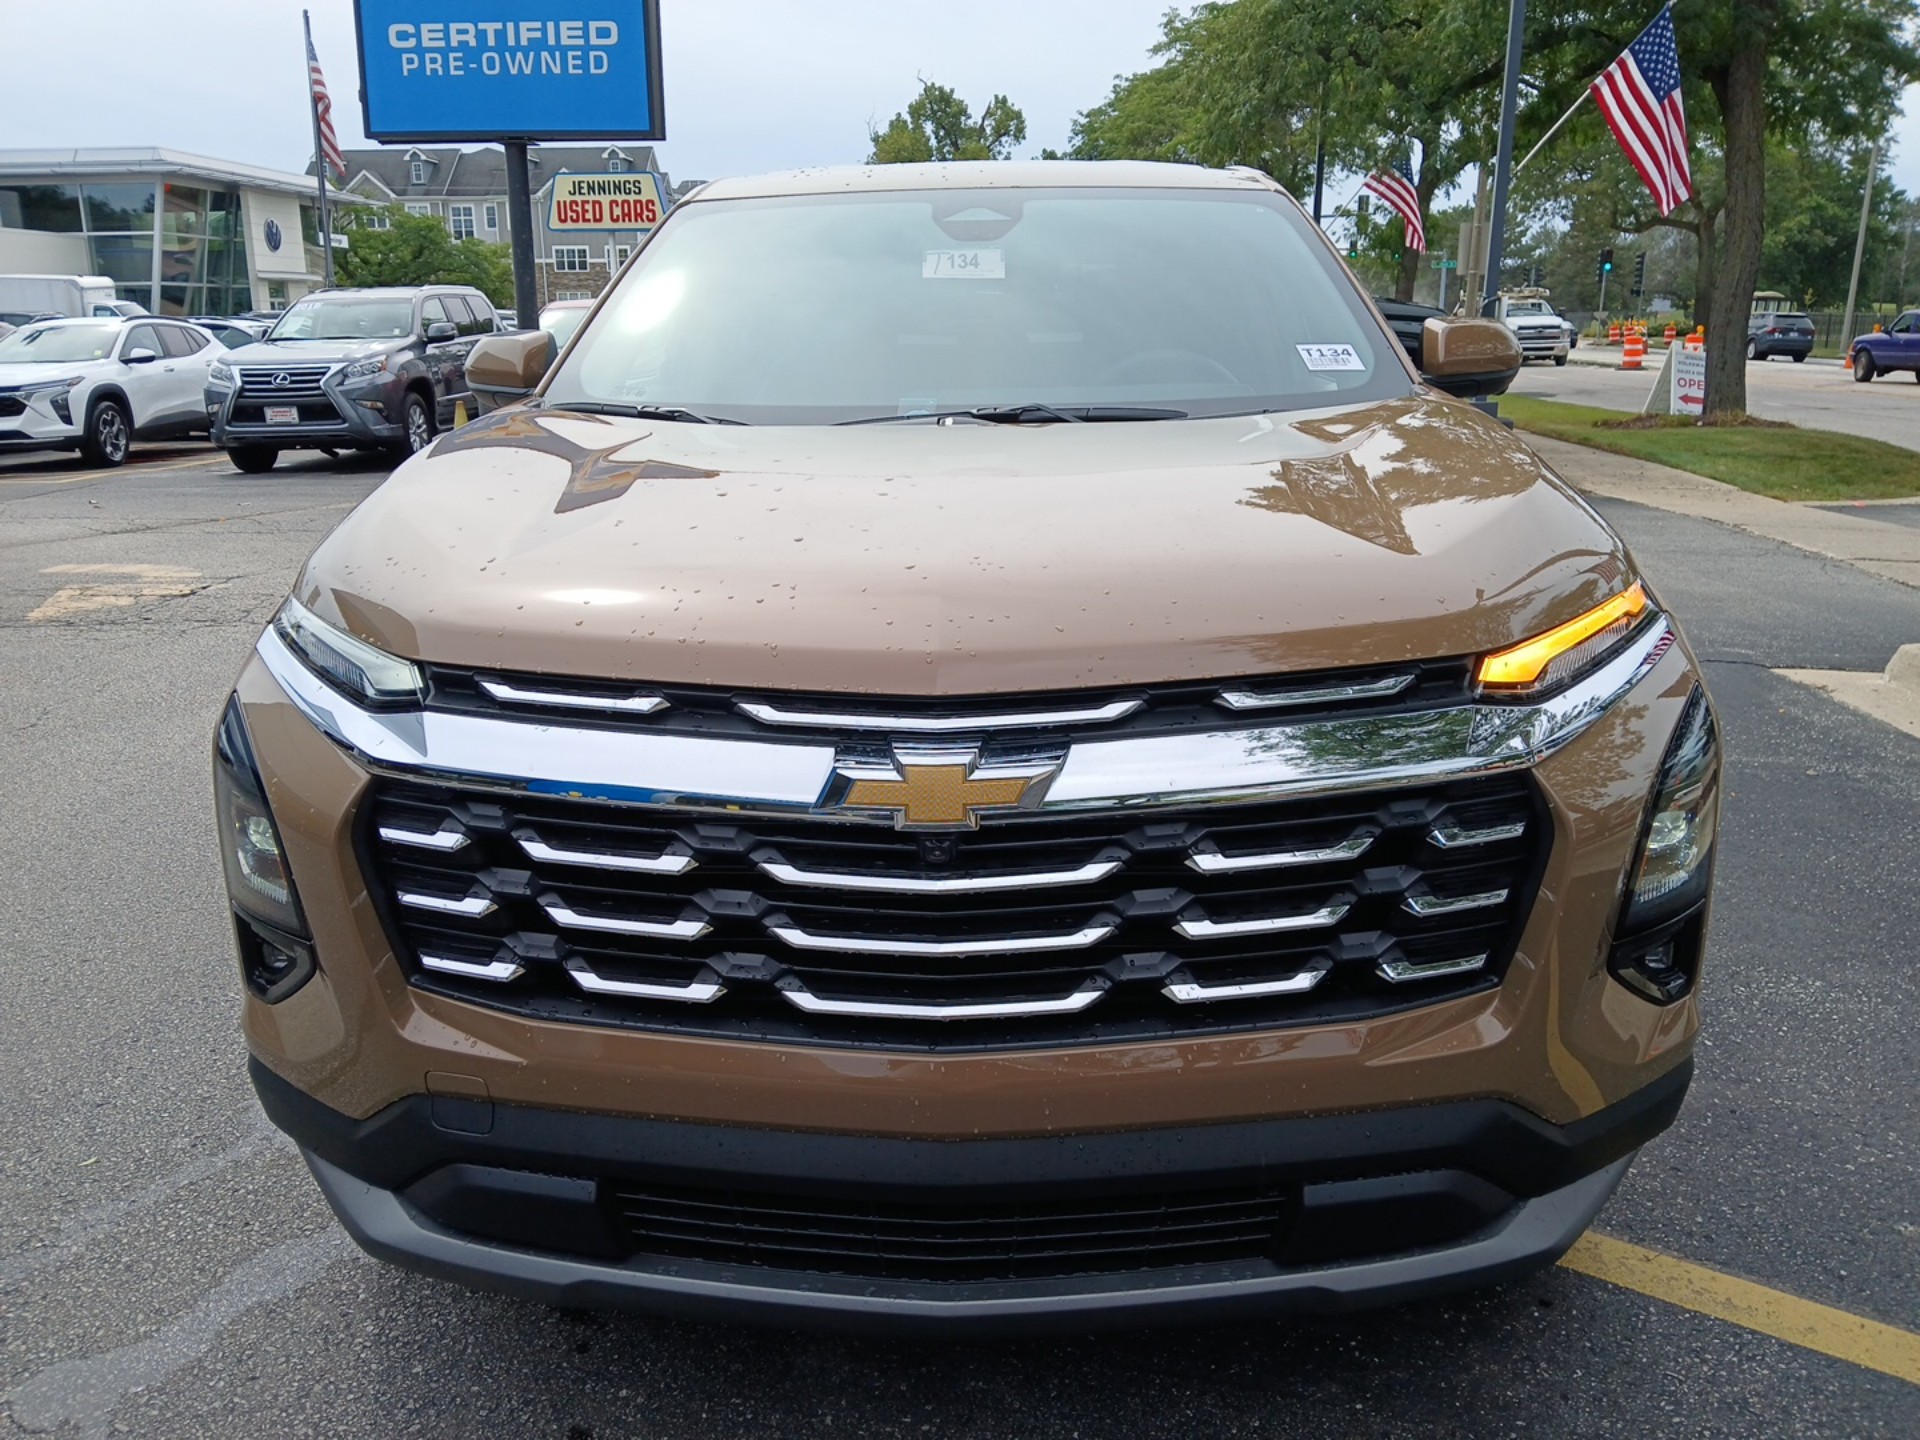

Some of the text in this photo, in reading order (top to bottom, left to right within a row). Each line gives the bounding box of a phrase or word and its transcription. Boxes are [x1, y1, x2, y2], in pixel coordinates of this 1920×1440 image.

[387, 20, 619, 49] CERTIFIED
[401, 50, 609, 76] PRE-OWNED
[567, 179, 643, 196] JENNINGS
[556, 199, 657, 223] USED CARS
[1301, 347, 1352, 357] T134
[1676, 377, 1705, 390] OPE
